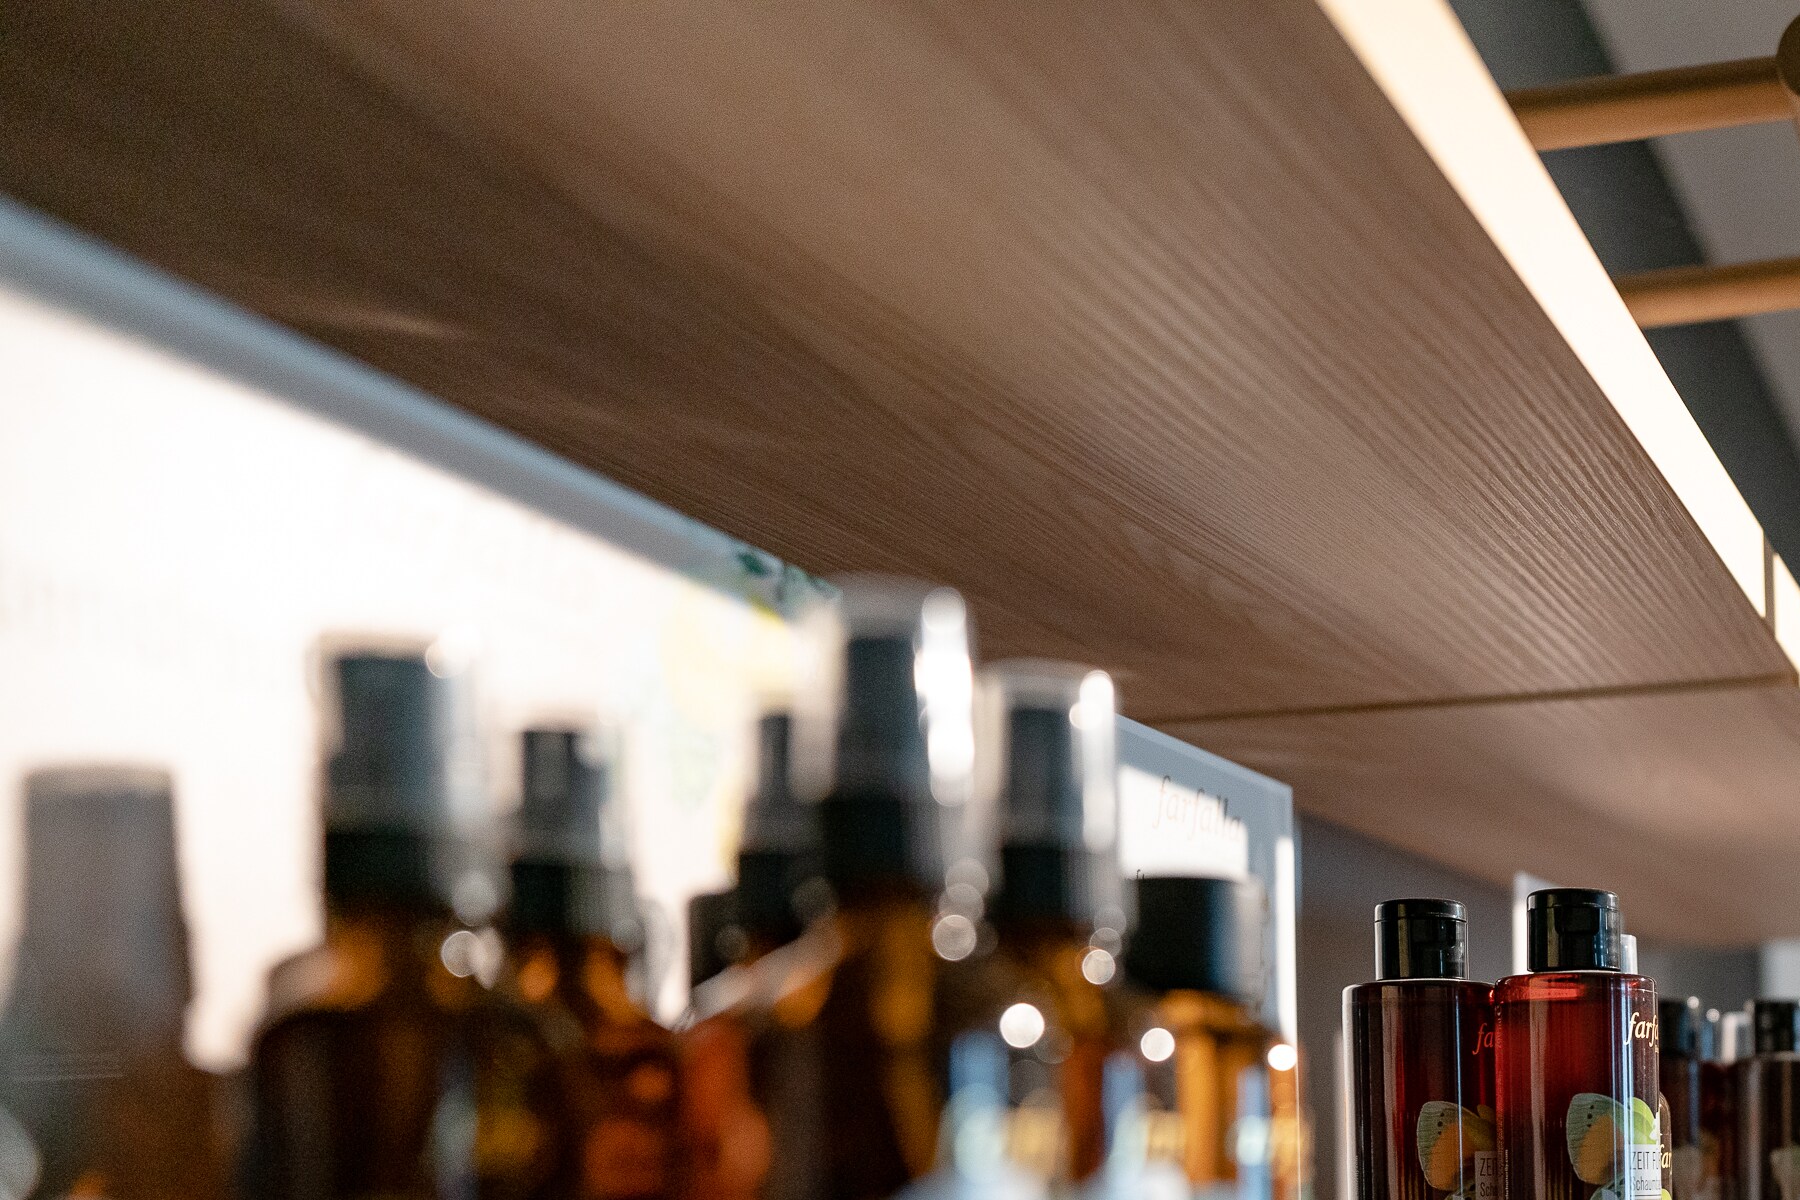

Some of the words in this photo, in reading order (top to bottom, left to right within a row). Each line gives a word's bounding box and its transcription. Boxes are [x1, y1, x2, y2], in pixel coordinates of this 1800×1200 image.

[1152, 775, 1241, 841] farfalla
[1471, 1022, 1494, 1055] fa
[1630, 1151, 1650, 1170] ZEIT
